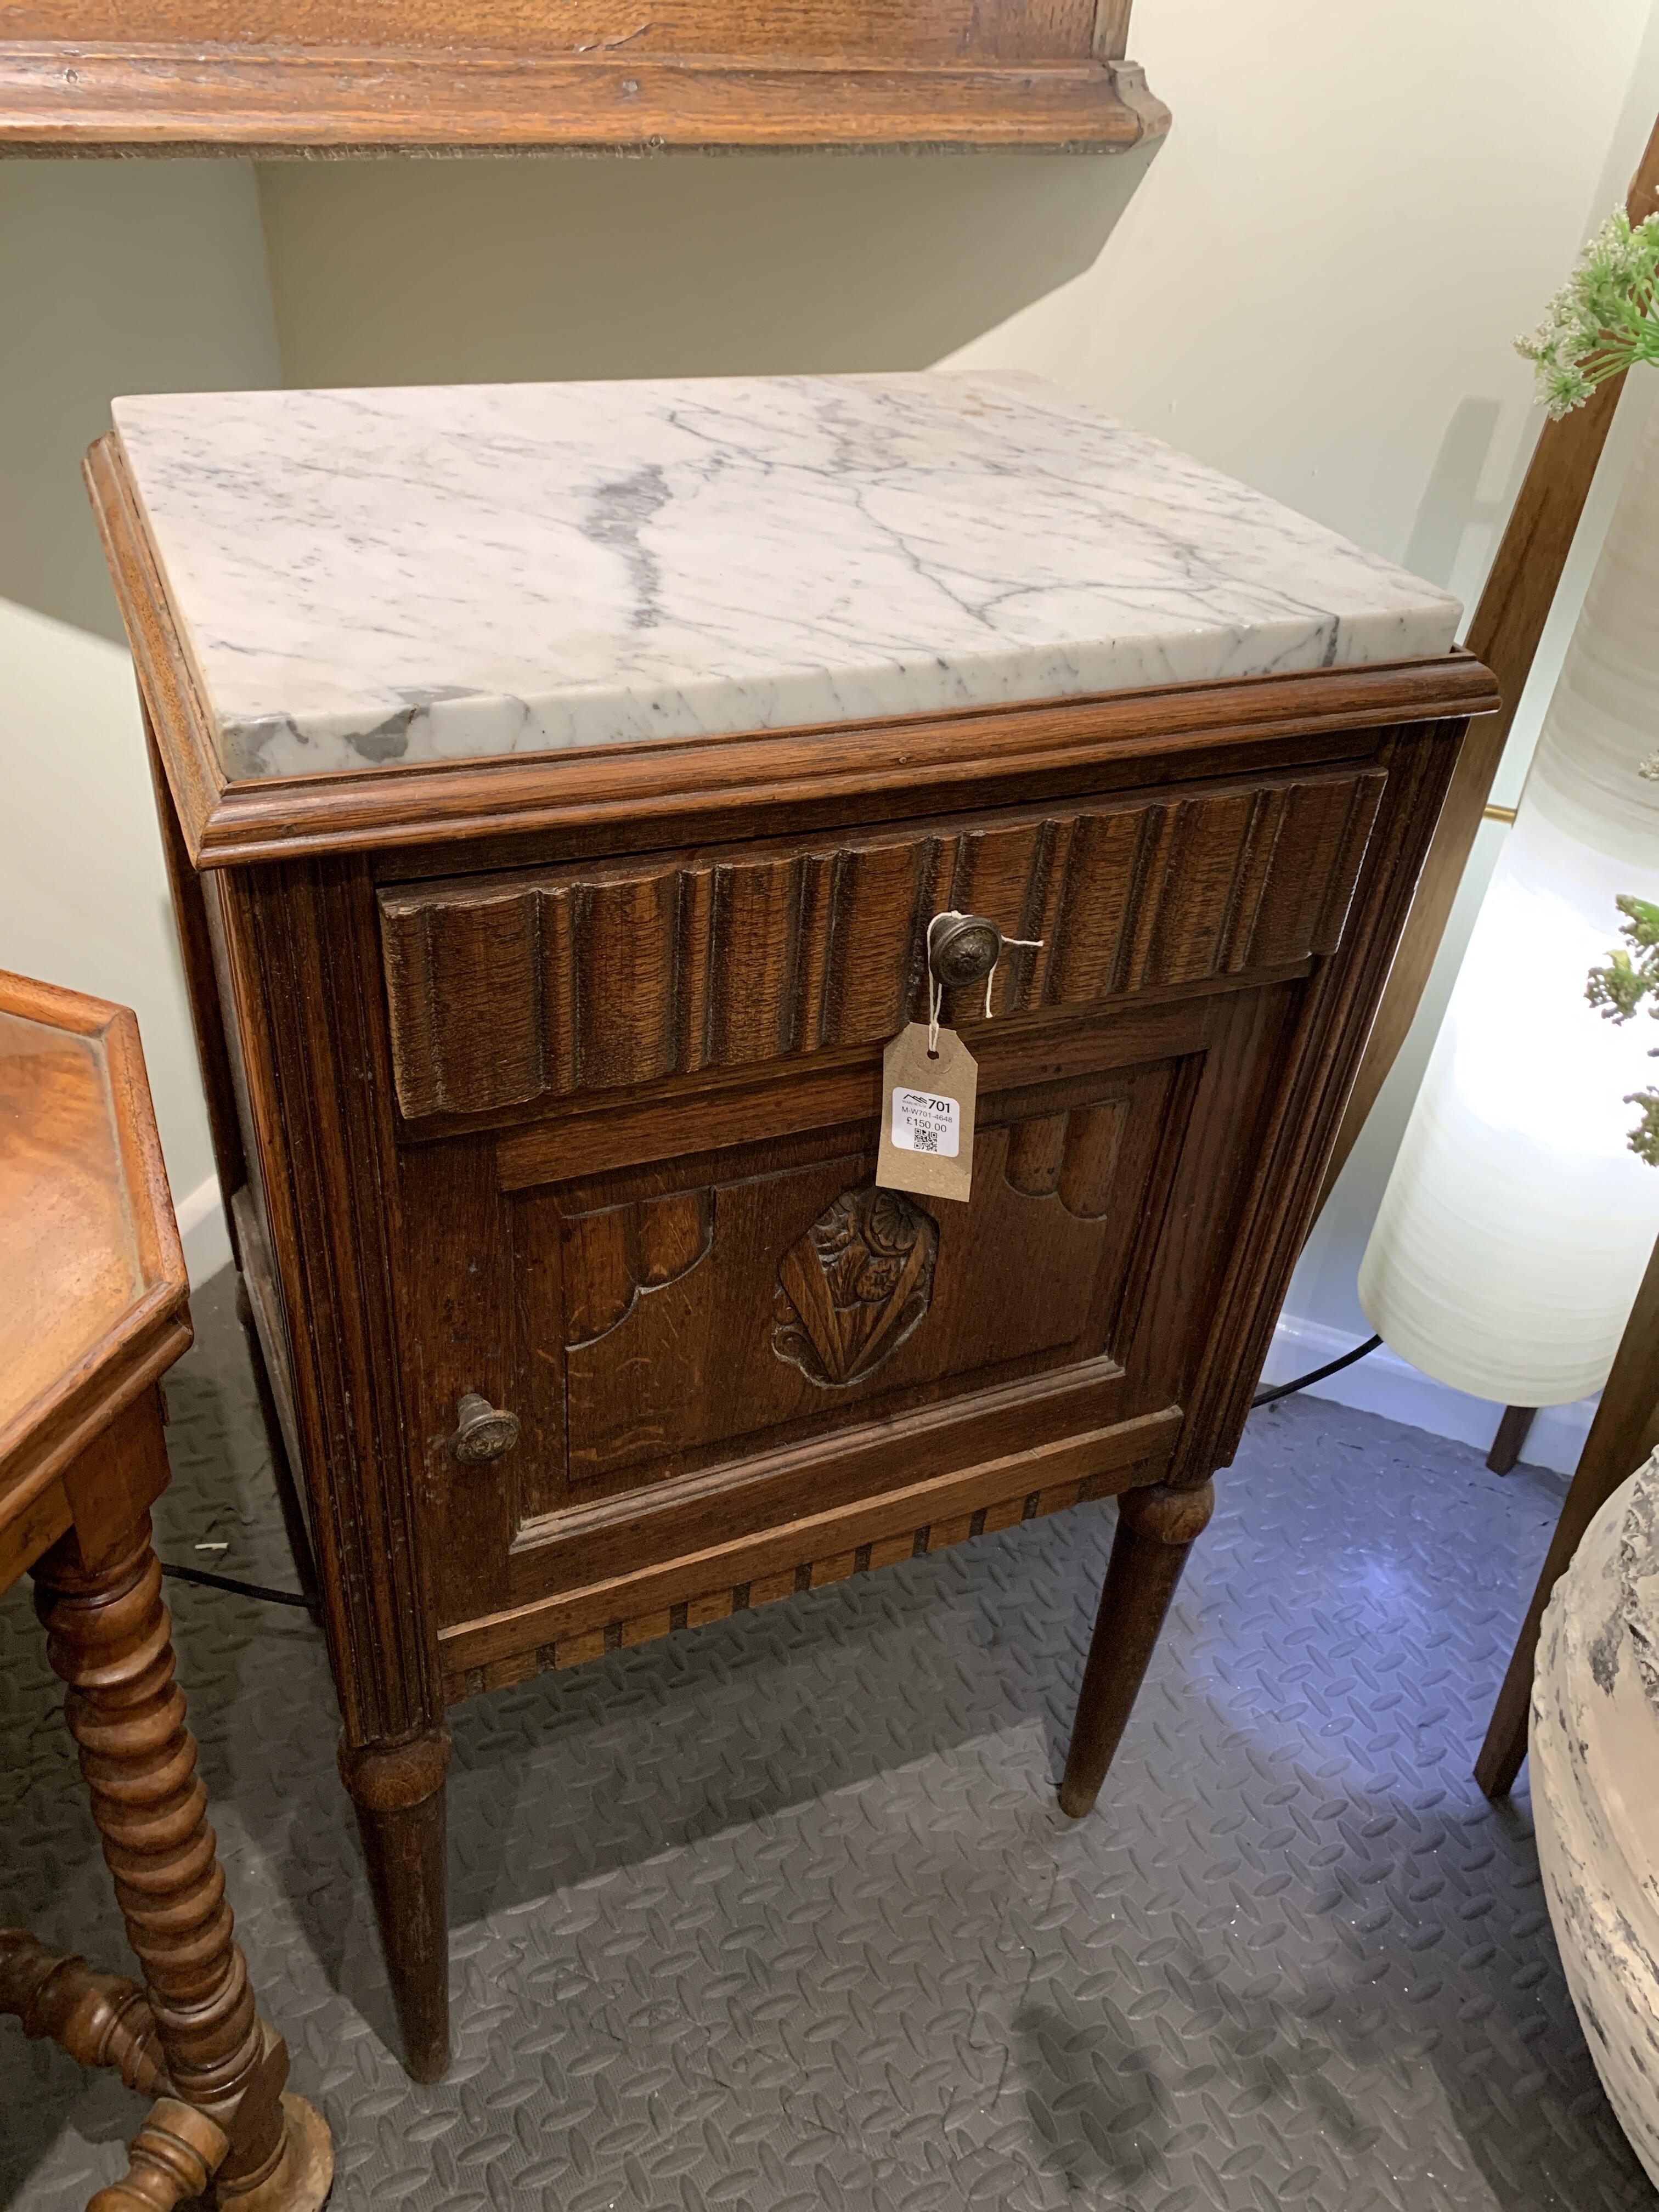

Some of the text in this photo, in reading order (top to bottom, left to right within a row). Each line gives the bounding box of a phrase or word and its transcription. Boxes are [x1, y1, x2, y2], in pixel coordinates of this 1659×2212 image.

[928, 1099, 950, 1113] 701
[901, 1106, 952, 1123] M-W701-4648
[906, 1116, 946, 1132] £150.00
